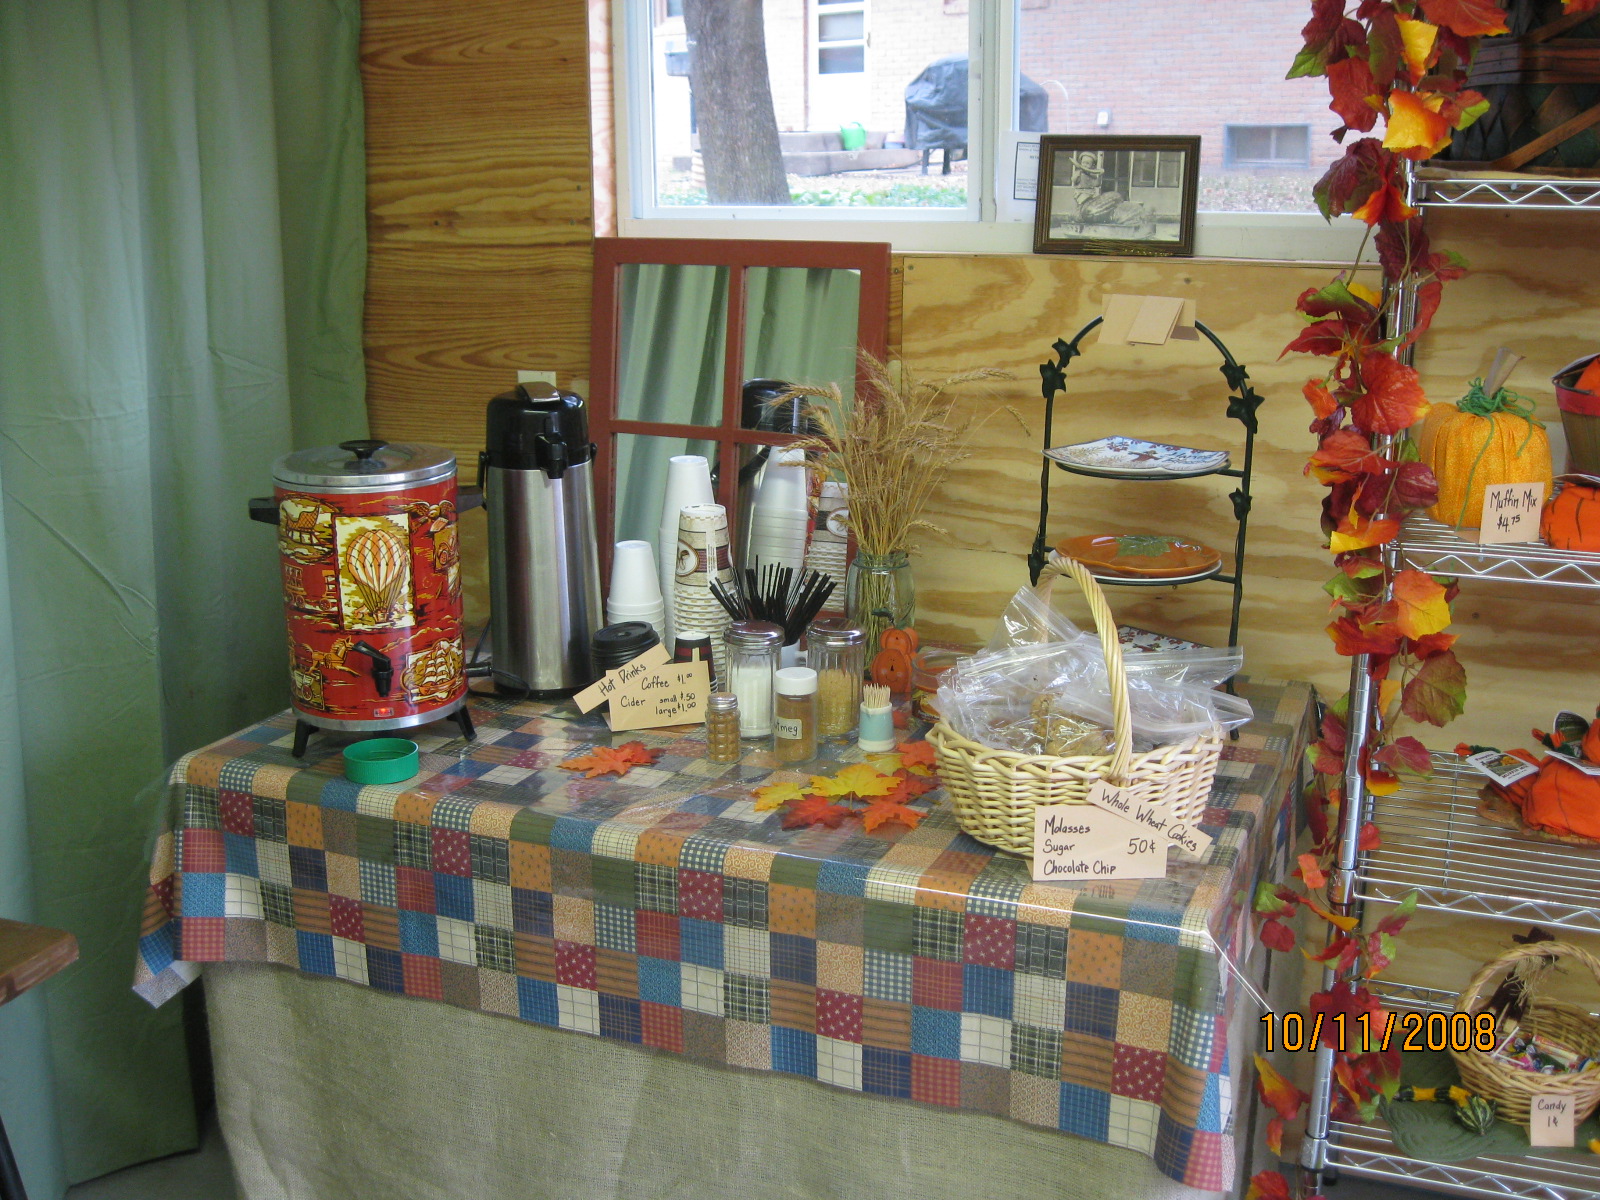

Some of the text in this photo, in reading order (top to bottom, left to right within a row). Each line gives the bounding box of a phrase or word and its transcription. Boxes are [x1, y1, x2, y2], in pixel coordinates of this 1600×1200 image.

[1489, 488, 1538, 513] Muffin Mix
[598, 663, 647, 696] Hot Drinks
[641, 675, 670, 690] Coffee
[620, 695, 646, 708] Cider
[659, 694, 678, 704] small
[655, 705, 678, 718] large
[1044, 814, 1091, 836] Molasses
[1101, 788, 1197, 852] Whole Wheat Cookies
[1042, 837, 1156, 856] Sugar 50¢
[1043, 859, 1116, 876] Chocolate Chip
[1537, 1098, 1567, 1114] Candy
